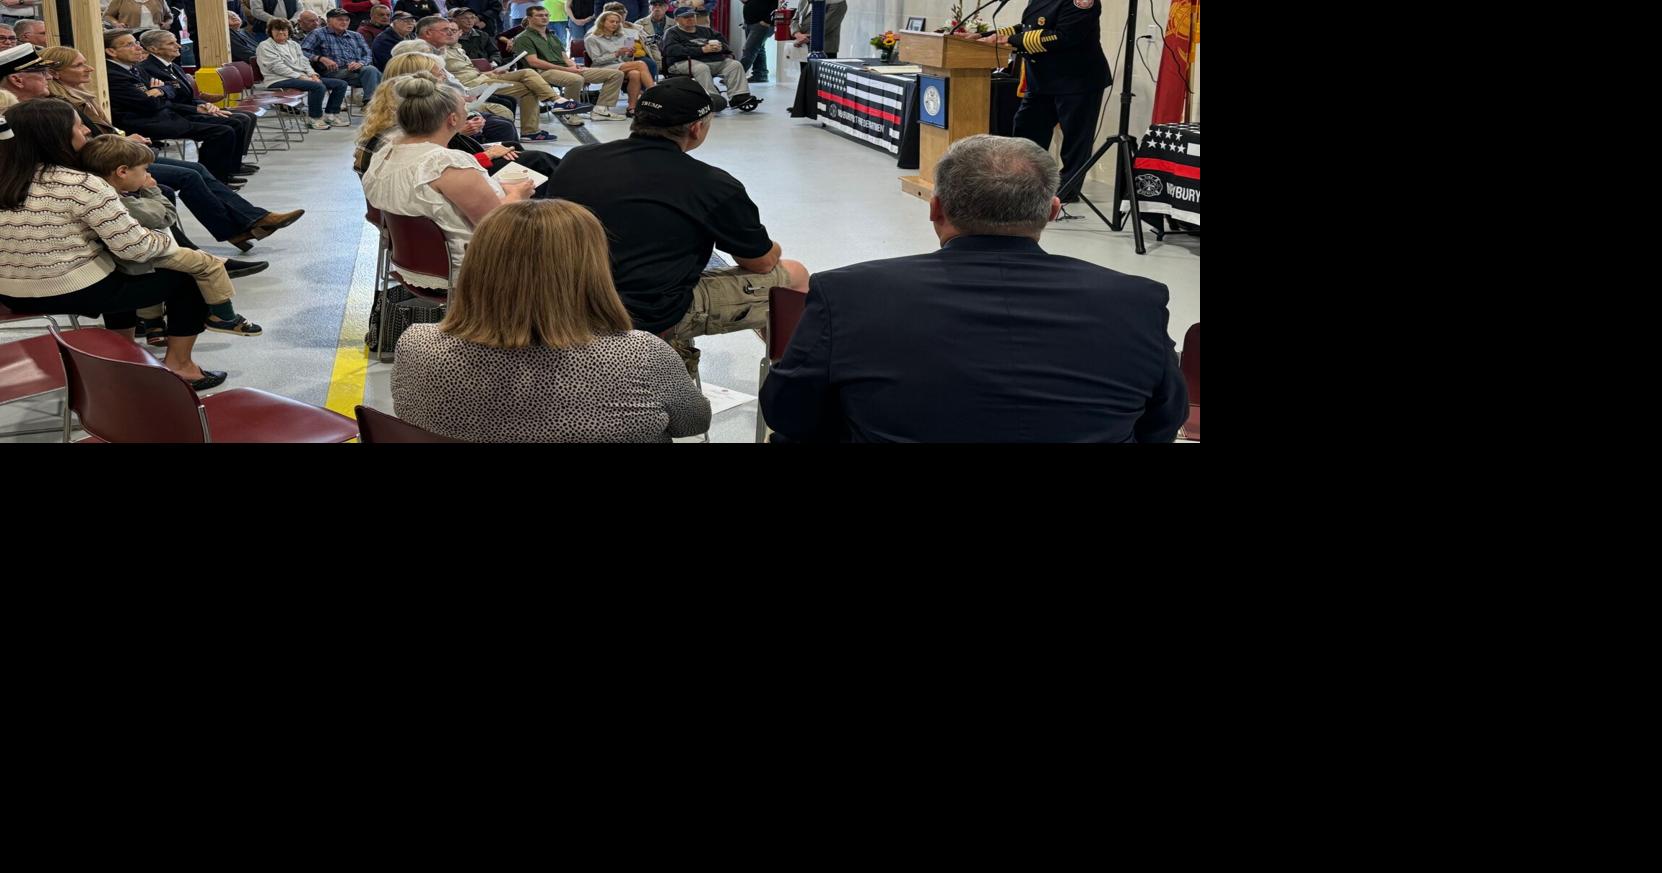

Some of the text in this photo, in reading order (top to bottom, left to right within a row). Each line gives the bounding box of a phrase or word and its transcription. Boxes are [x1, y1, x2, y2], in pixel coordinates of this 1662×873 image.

[641, 101, 662, 109] TRUMP
[697, 105, 710, 116] 2024
[1166, 182, 1200, 203] NWBURY
